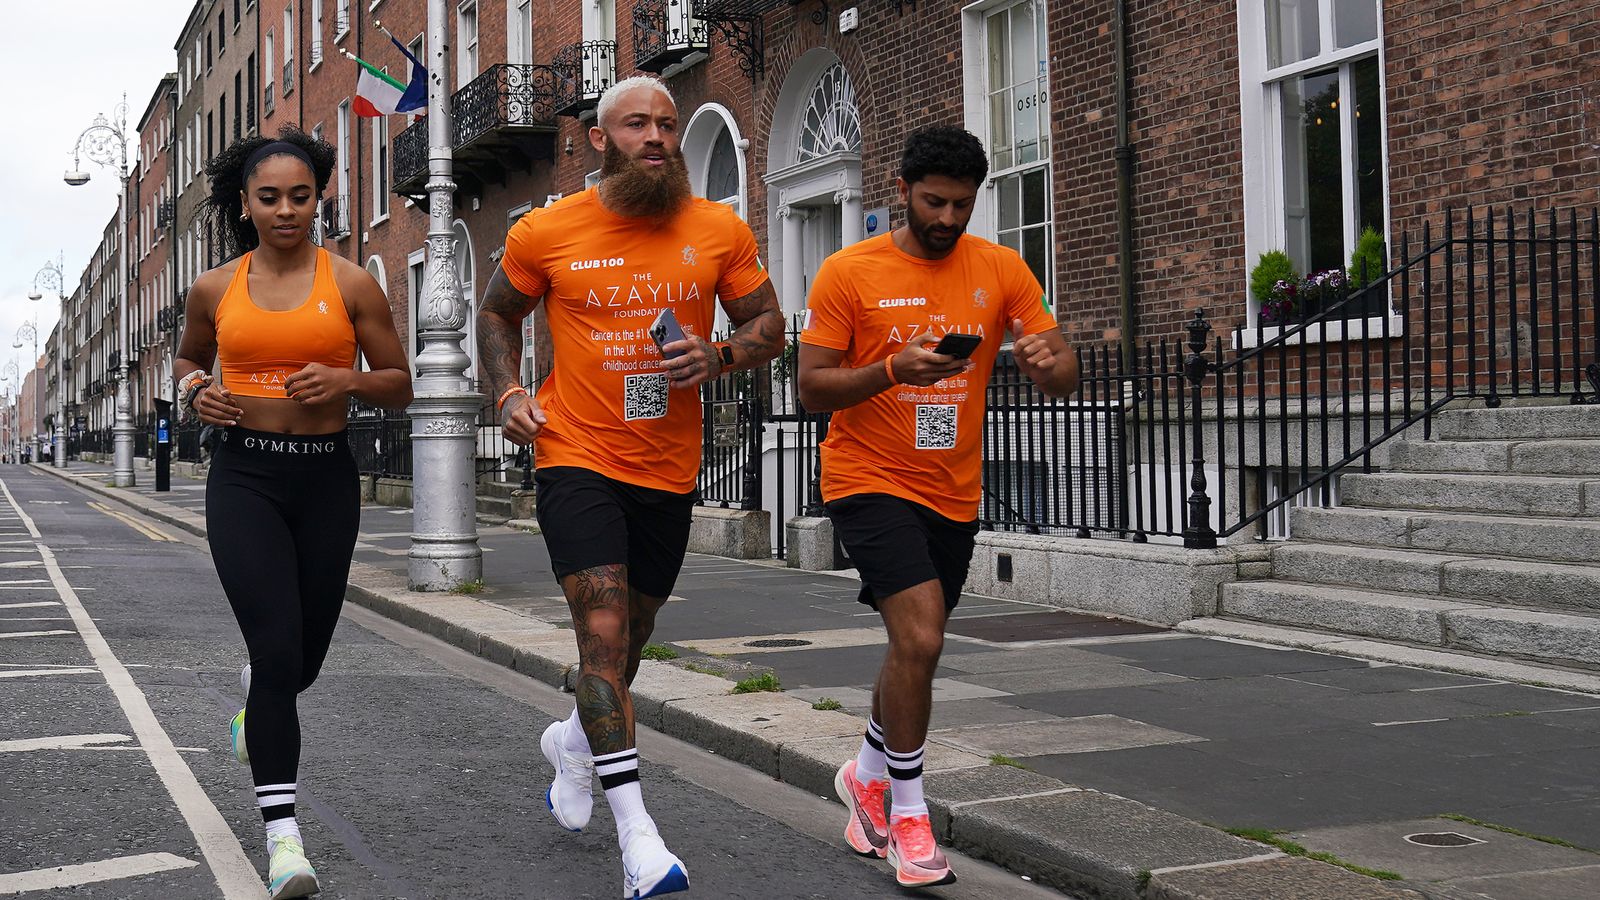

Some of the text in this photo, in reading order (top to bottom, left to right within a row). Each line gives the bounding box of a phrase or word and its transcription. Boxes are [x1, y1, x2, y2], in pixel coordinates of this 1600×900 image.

[570, 257, 625, 271] CLUB100
[633, 273, 652, 281] THE
[585, 282, 700, 308] AZAYLIA
[879, 297, 927, 308] CLUB100
[614, 307, 676, 318] FOUNDATI
[590, 329, 614, 341] Cancer
[615, 330, 621, 341] is
[622, 329, 634, 341] the
[636, 327, 645, 340] #1
[604, 345, 611, 356] in
[613, 344, 625, 356] the
[626, 344, 637, 356] UK
[602, 359, 638, 371] childhood
[249, 373, 292, 384] AZAY
[957, 376, 968, 387] fun
[897, 390, 929, 403] childhood
[930, 393, 950, 403] cancer
[159, 418, 167, 429] P
[244, 436, 335, 454] GYMKING
